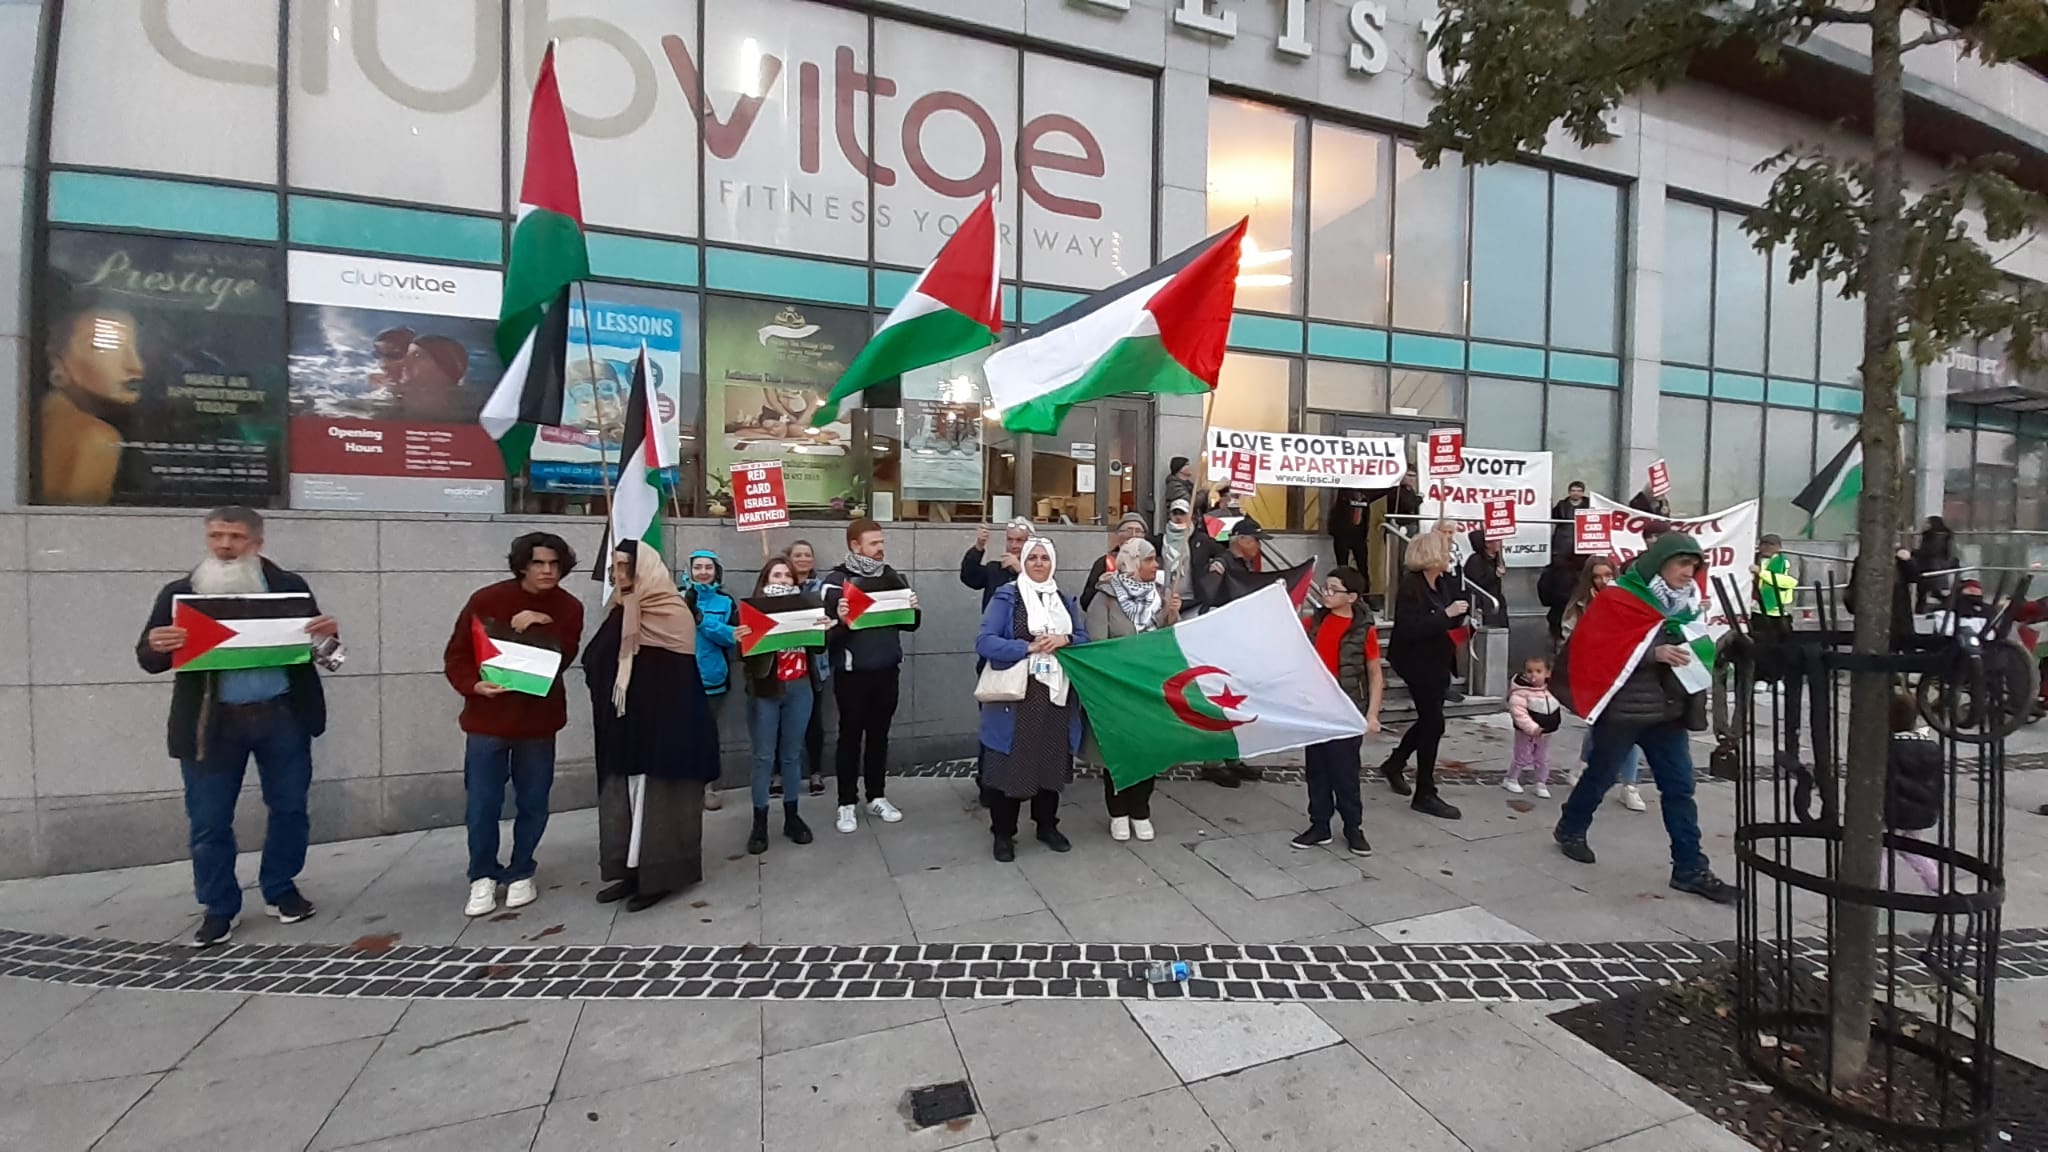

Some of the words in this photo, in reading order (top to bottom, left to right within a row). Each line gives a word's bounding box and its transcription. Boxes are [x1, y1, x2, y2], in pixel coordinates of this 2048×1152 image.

[719, 180, 892, 229] FITNESS
[914, 210, 1011, 246] YOR
[1033, 228, 1104, 258] WAY
[80, 250, 257, 311] Prestige
[341, 269, 456, 294] clubvitae
[597, 311, 673, 338] LESSONS
[328, 426, 383, 441] Opening
[345, 442, 383, 453] Hours
[1215, 431, 1273, 451] LOVE
[1281, 437, 1396, 458] FOOTBALL
[1211, 451, 1272, 471] HE
[1279, 455, 1400, 476] APARTHEID
[1460, 457, 1527, 475] YCOTT
[747, 469, 766, 481] RED
[1275, 474, 1341, 485] www.ipsc.ie
[746, 482, 771, 495] CARD
[744, 496, 777, 509] ISRAELI
[739, 509, 786, 523] APARTHEID
